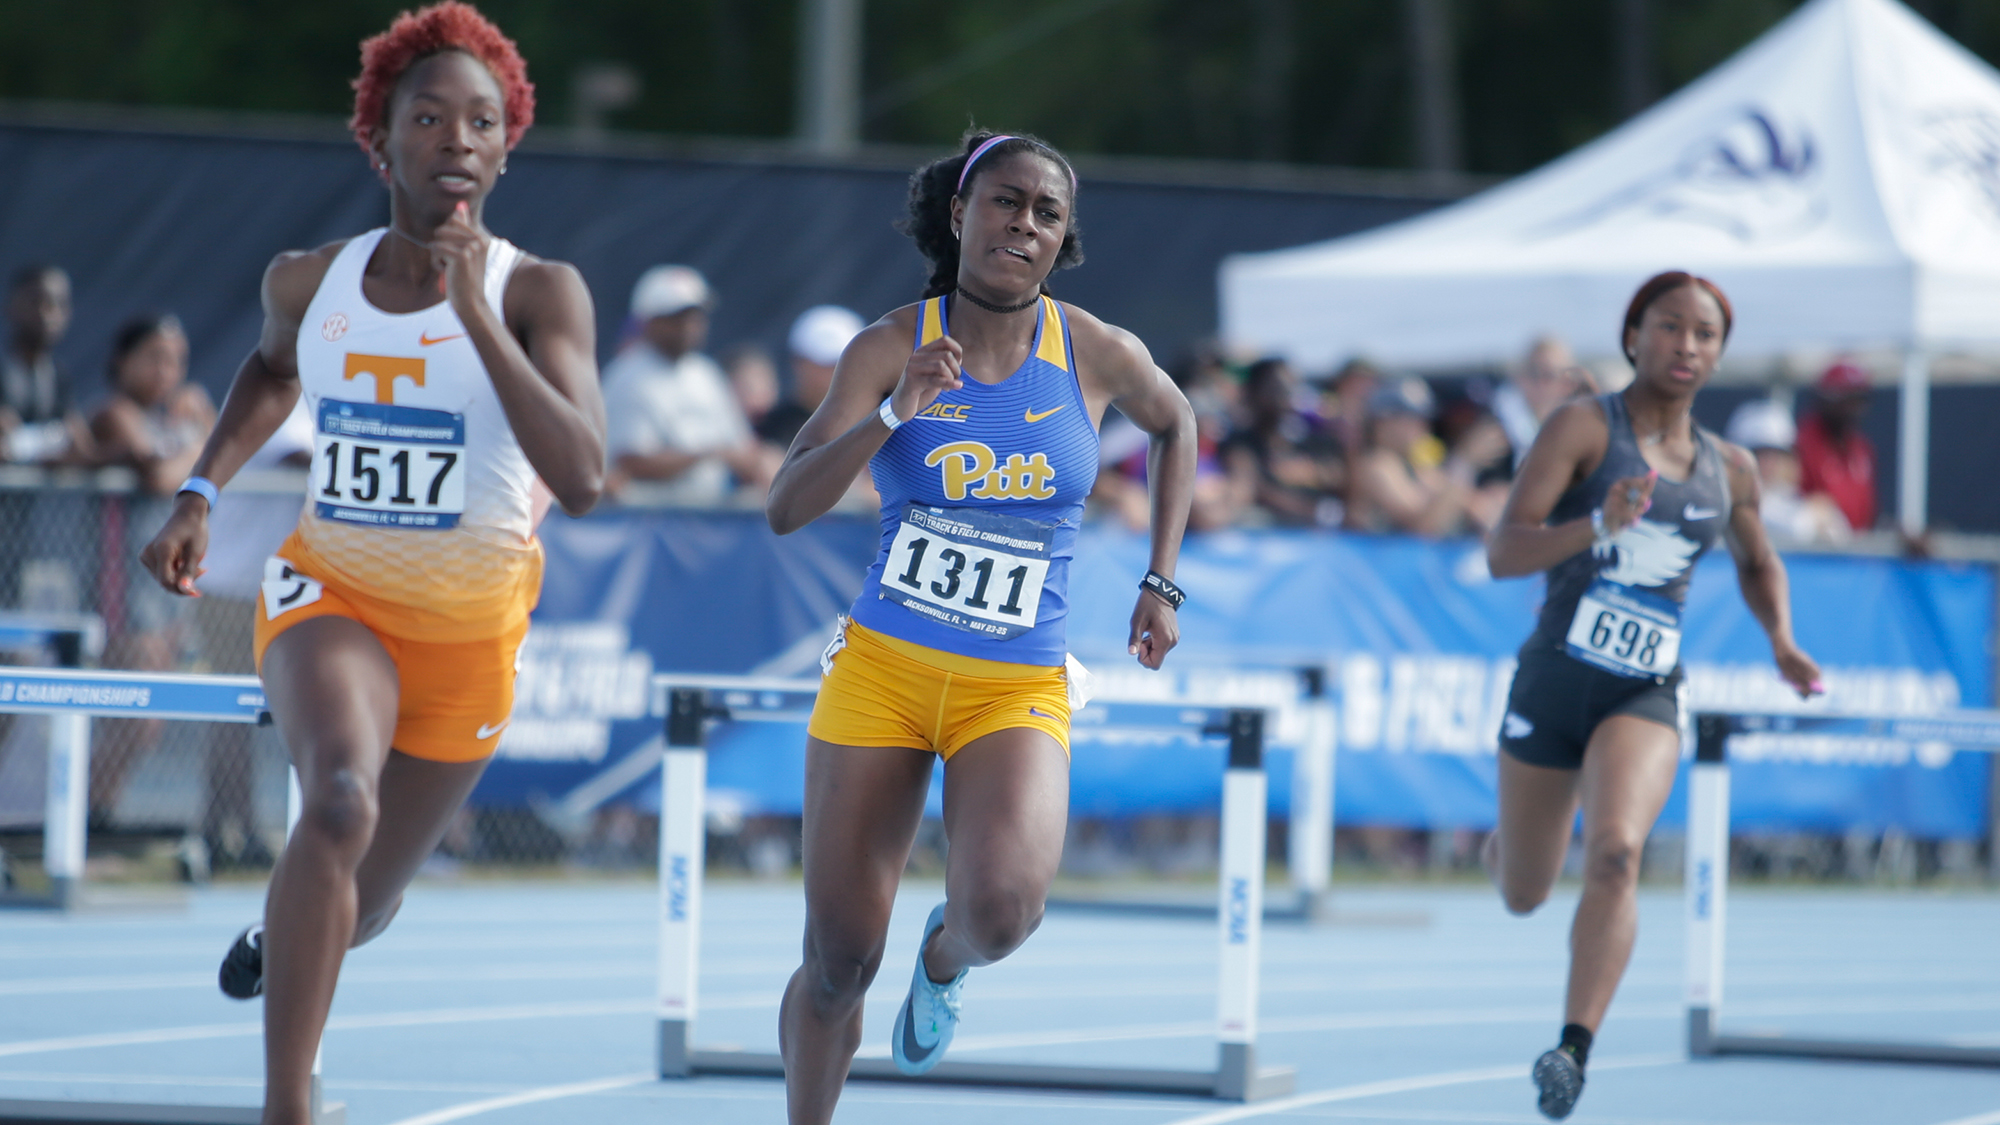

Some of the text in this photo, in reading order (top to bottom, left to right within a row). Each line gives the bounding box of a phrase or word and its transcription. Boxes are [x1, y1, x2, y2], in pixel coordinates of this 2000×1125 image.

[343, 353, 425, 404] T
[919, 403, 973, 419] ACC
[322, 442, 457, 507] 1517
[924, 440, 1057, 501] Pitt
[926, 517, 952, 534] TRACK
[957, 527, 981, 539] FIELD
[980, 530, 1045, 552] CHAMPIONSHIPS
[898, 537, 1028, 617] 1311
[1142, 574, 1185, 605] EVAT
[902, 599, 1007, 636] JACKSONVILLE, FL MAY 23-25
[1591, 610, 1662, 667] 698
[16, 683, 151, 708] CHAMPIONSHIPS
